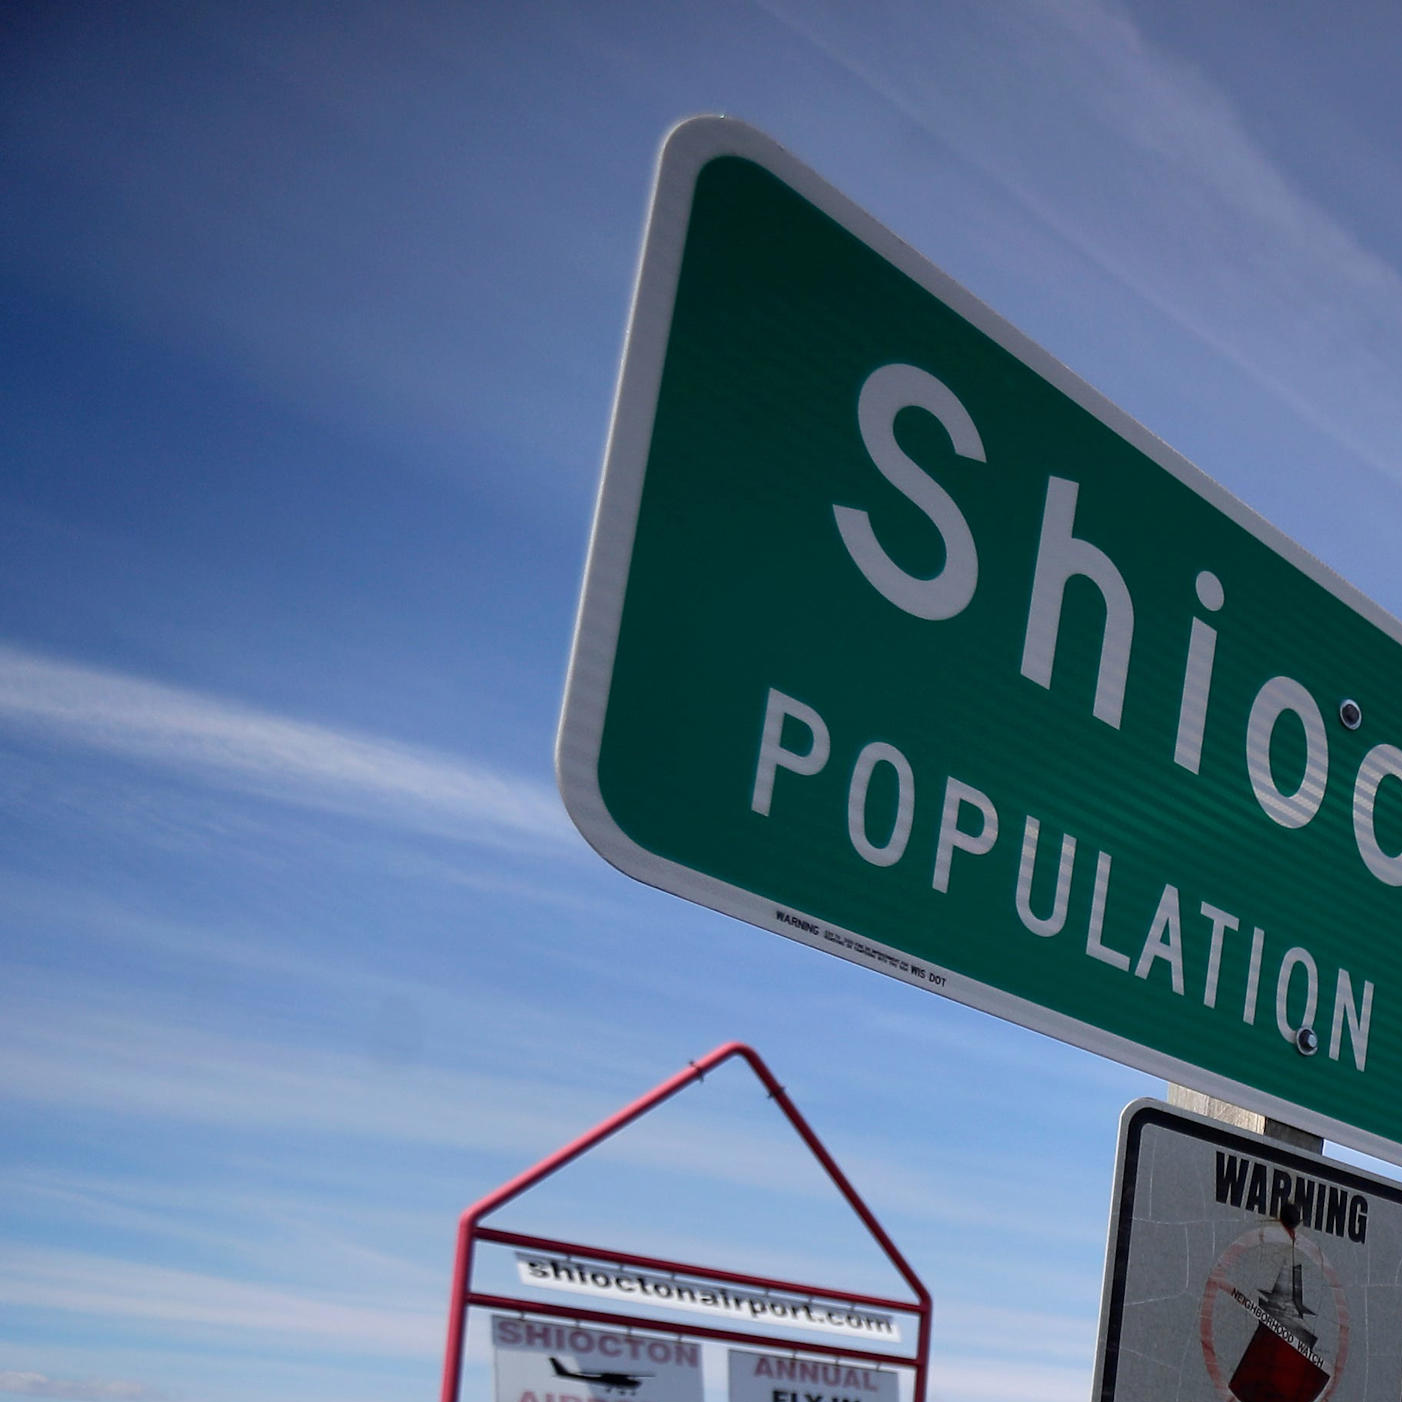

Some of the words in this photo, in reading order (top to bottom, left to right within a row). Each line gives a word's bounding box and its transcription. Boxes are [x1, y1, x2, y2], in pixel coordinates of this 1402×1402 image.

[751, 687, 1374, 1071] POPULATION
[776, 911, 819, 935] WARNING
[929, 973, 947, 987] DOT
[1215, 1151, 1368, 1244] WARNING
[528, 1258, 894, 1336] shioctonairport.com
[1230, 1287, 1294, 1344] NEIGHBORHOOD
[1297, 1341, 1324, 1368] WATCH
[498, 1321, 699, 1368] SHIOCTON
[754, 1356, 878, 1392] ANNUAL
